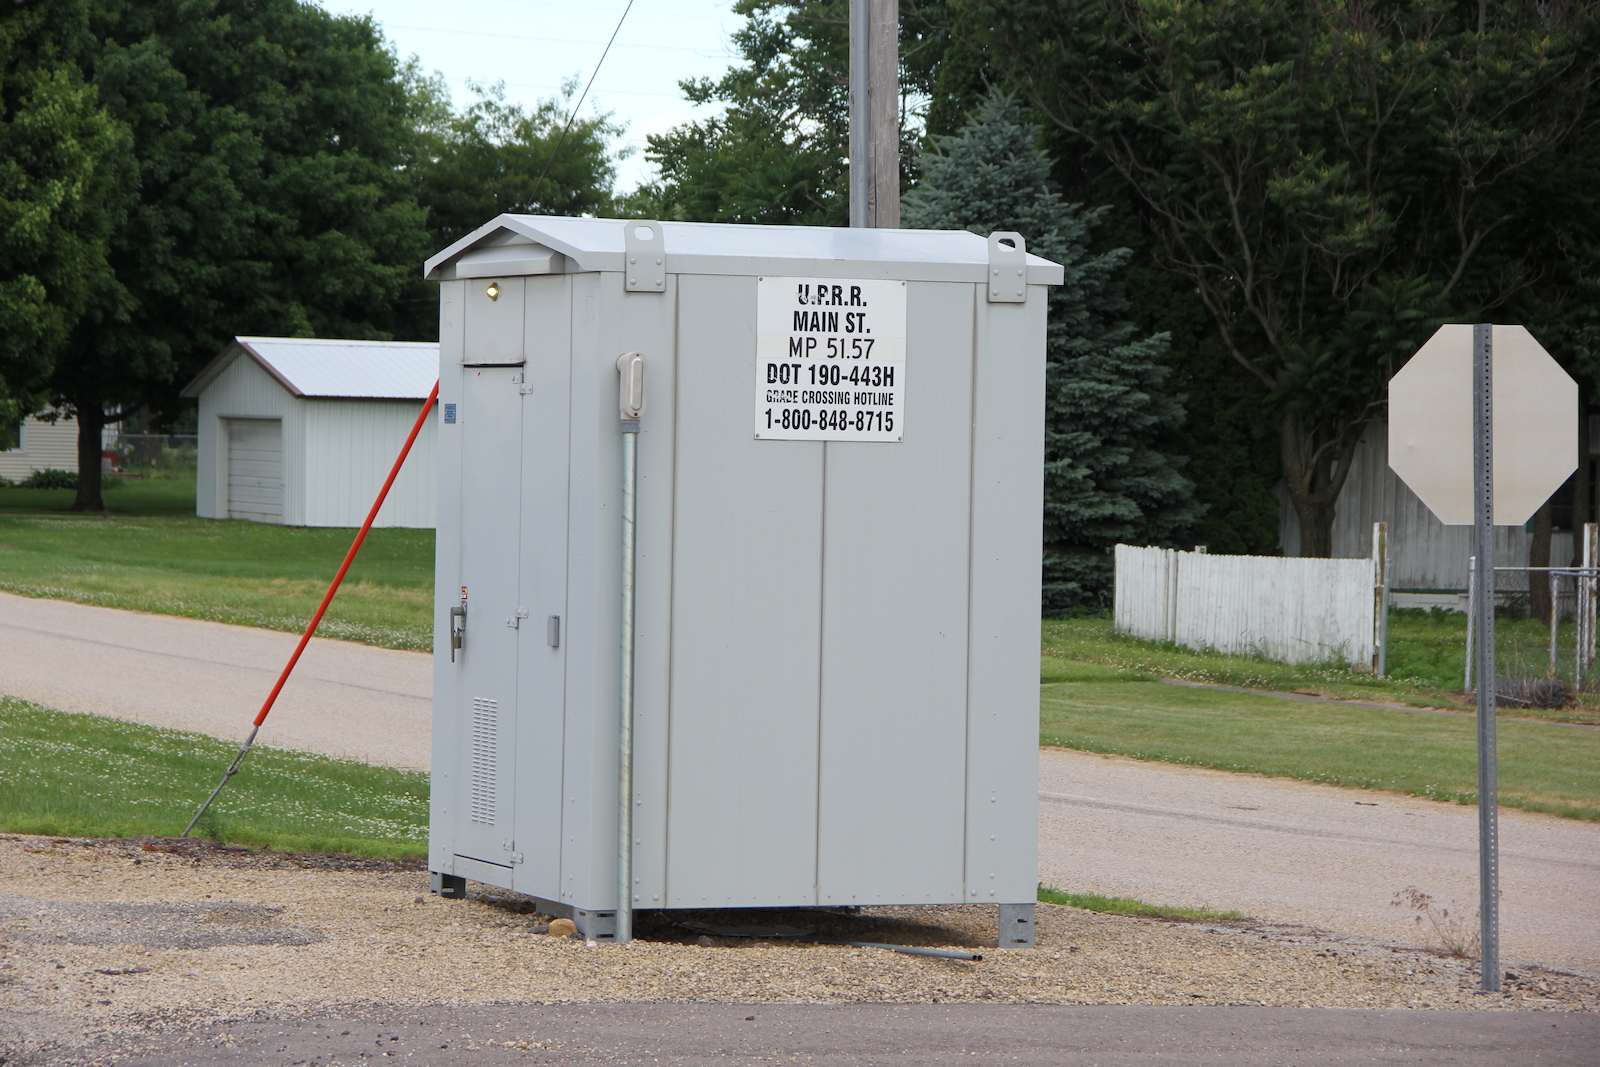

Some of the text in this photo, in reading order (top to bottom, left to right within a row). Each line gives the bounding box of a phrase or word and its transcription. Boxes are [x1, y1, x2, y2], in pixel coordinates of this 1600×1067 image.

[798, 284, 867, 307] U.P.R.R.
[793, 310, 871, 334] MAIN ST.
[789, 336, 875, 360] MP 51.57
[767, 363, 894, 387] DOT 190-443H
[766, 389, 894, 406] GRADE CROSSING HOTLINE
[765, 408, 894, 432] 1-800-848-8715
